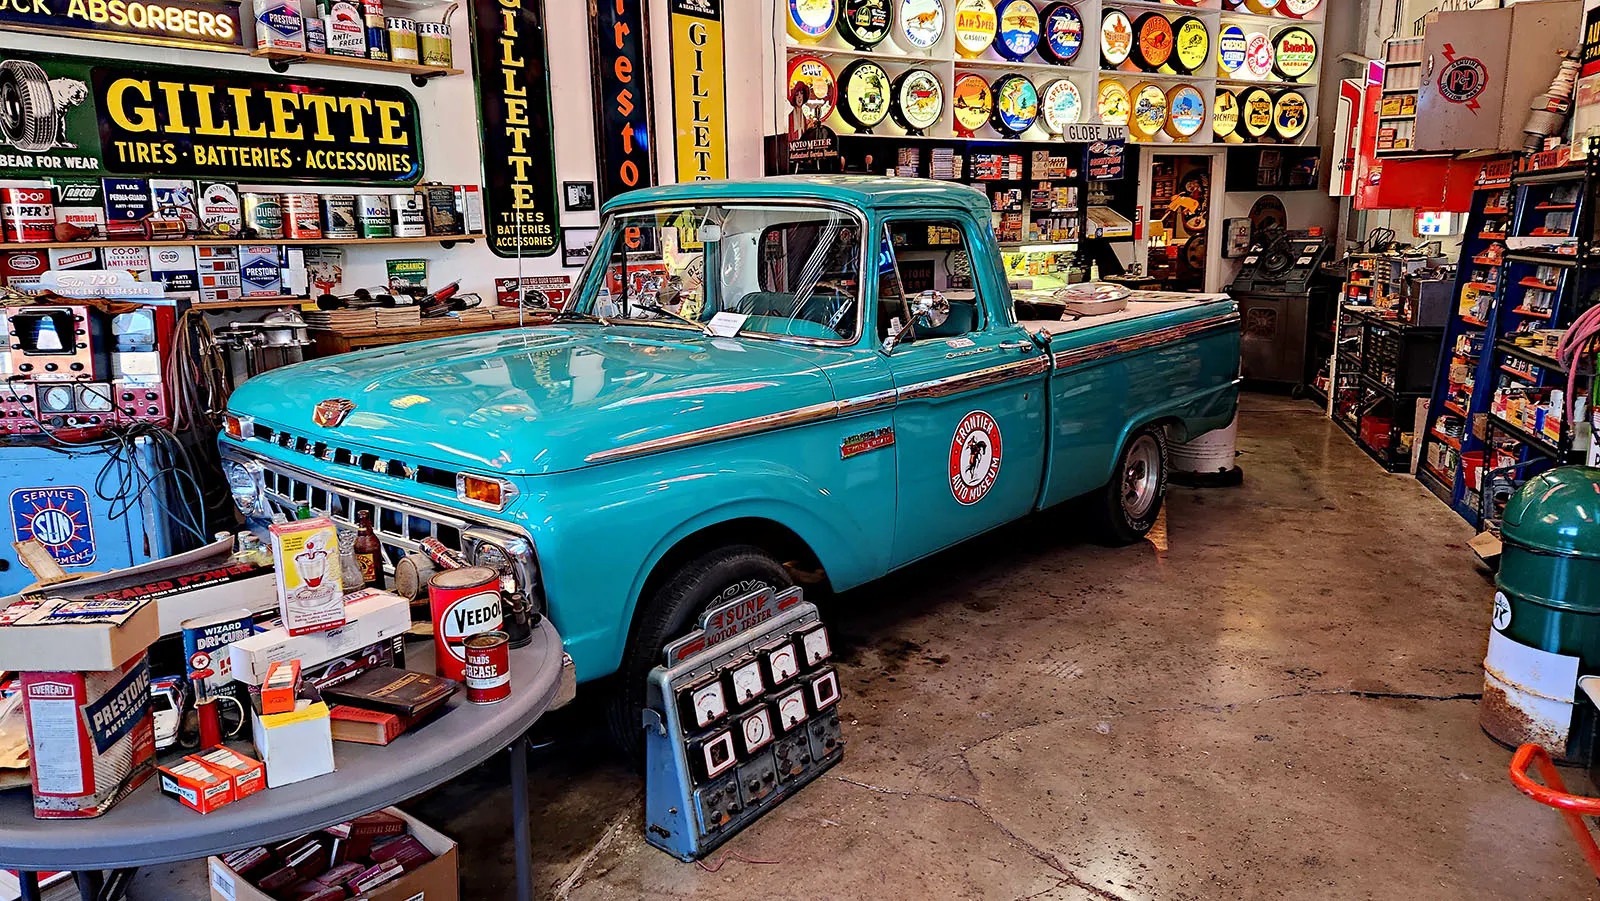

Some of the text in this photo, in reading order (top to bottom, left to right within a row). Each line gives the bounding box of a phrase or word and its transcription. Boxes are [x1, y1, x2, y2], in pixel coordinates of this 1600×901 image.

[0, 0, 233, 38] CK ABSORBERS
[269, 13, 301, 26] PRESTONE
[339, 37, 363, 47] FREEZE
[1451, 59, 1479, 70] GENUINE
[855, 65, 886, 80] POLLY
[1450, 69, 1477, 91] P&D
[107, 78, 409, 146] GILLETTE
[1069, 125, 1123, 140] GLOBE AVE
[0, 155, 99, 170] BEAR FOR WEAR
[115, 142, 412, 173] TIRES BATTERIES ACCESSORIES
[208, 185, 233, 196] WESTLAND
[6, 206, 42, 216] SPER
[501, 212, 544, 222] TIRES
[205, 214, 227, 224] ANTI-
[497, 224, 551, 235] BATTERIES
[496, 236, 553, 247] ACCESSORIES
[60, 253, 91, 265] TRAVELLER
[107, 259, 147, 267] ANTI-FREEZE
[246, 267, 278, 276] PRESTONE
[56, 273, 118, 287] Sun 720
[219, 275, 238, 285] FREEZE
[83, 288, 115, 296] ENGINE
[956, 415, 993, 446] FRONTIER
[951, 457, 1000, 500] AUTO MUSEUM
[22, 490, 75, 503] SERVICE
[35, 511, 71, 544] SUN
[55, 548, 90, 564] PMENT
[94, 564, 254, 600] SEALED POWER
[726, 597, 757, 625] SUN
[204, 621, 242, 636] WIZARD
[707, 608, 772, 647] MOTOR TESTER
[468, 655, 490, 665] WARDS
[32, 686, 70, 695] EVEREADY
[92, 669, 149, 732] PRESTONE
[105, 691, 148, 739] ANTI-FREEZE
[384, 824, 402, 833] SEALS
